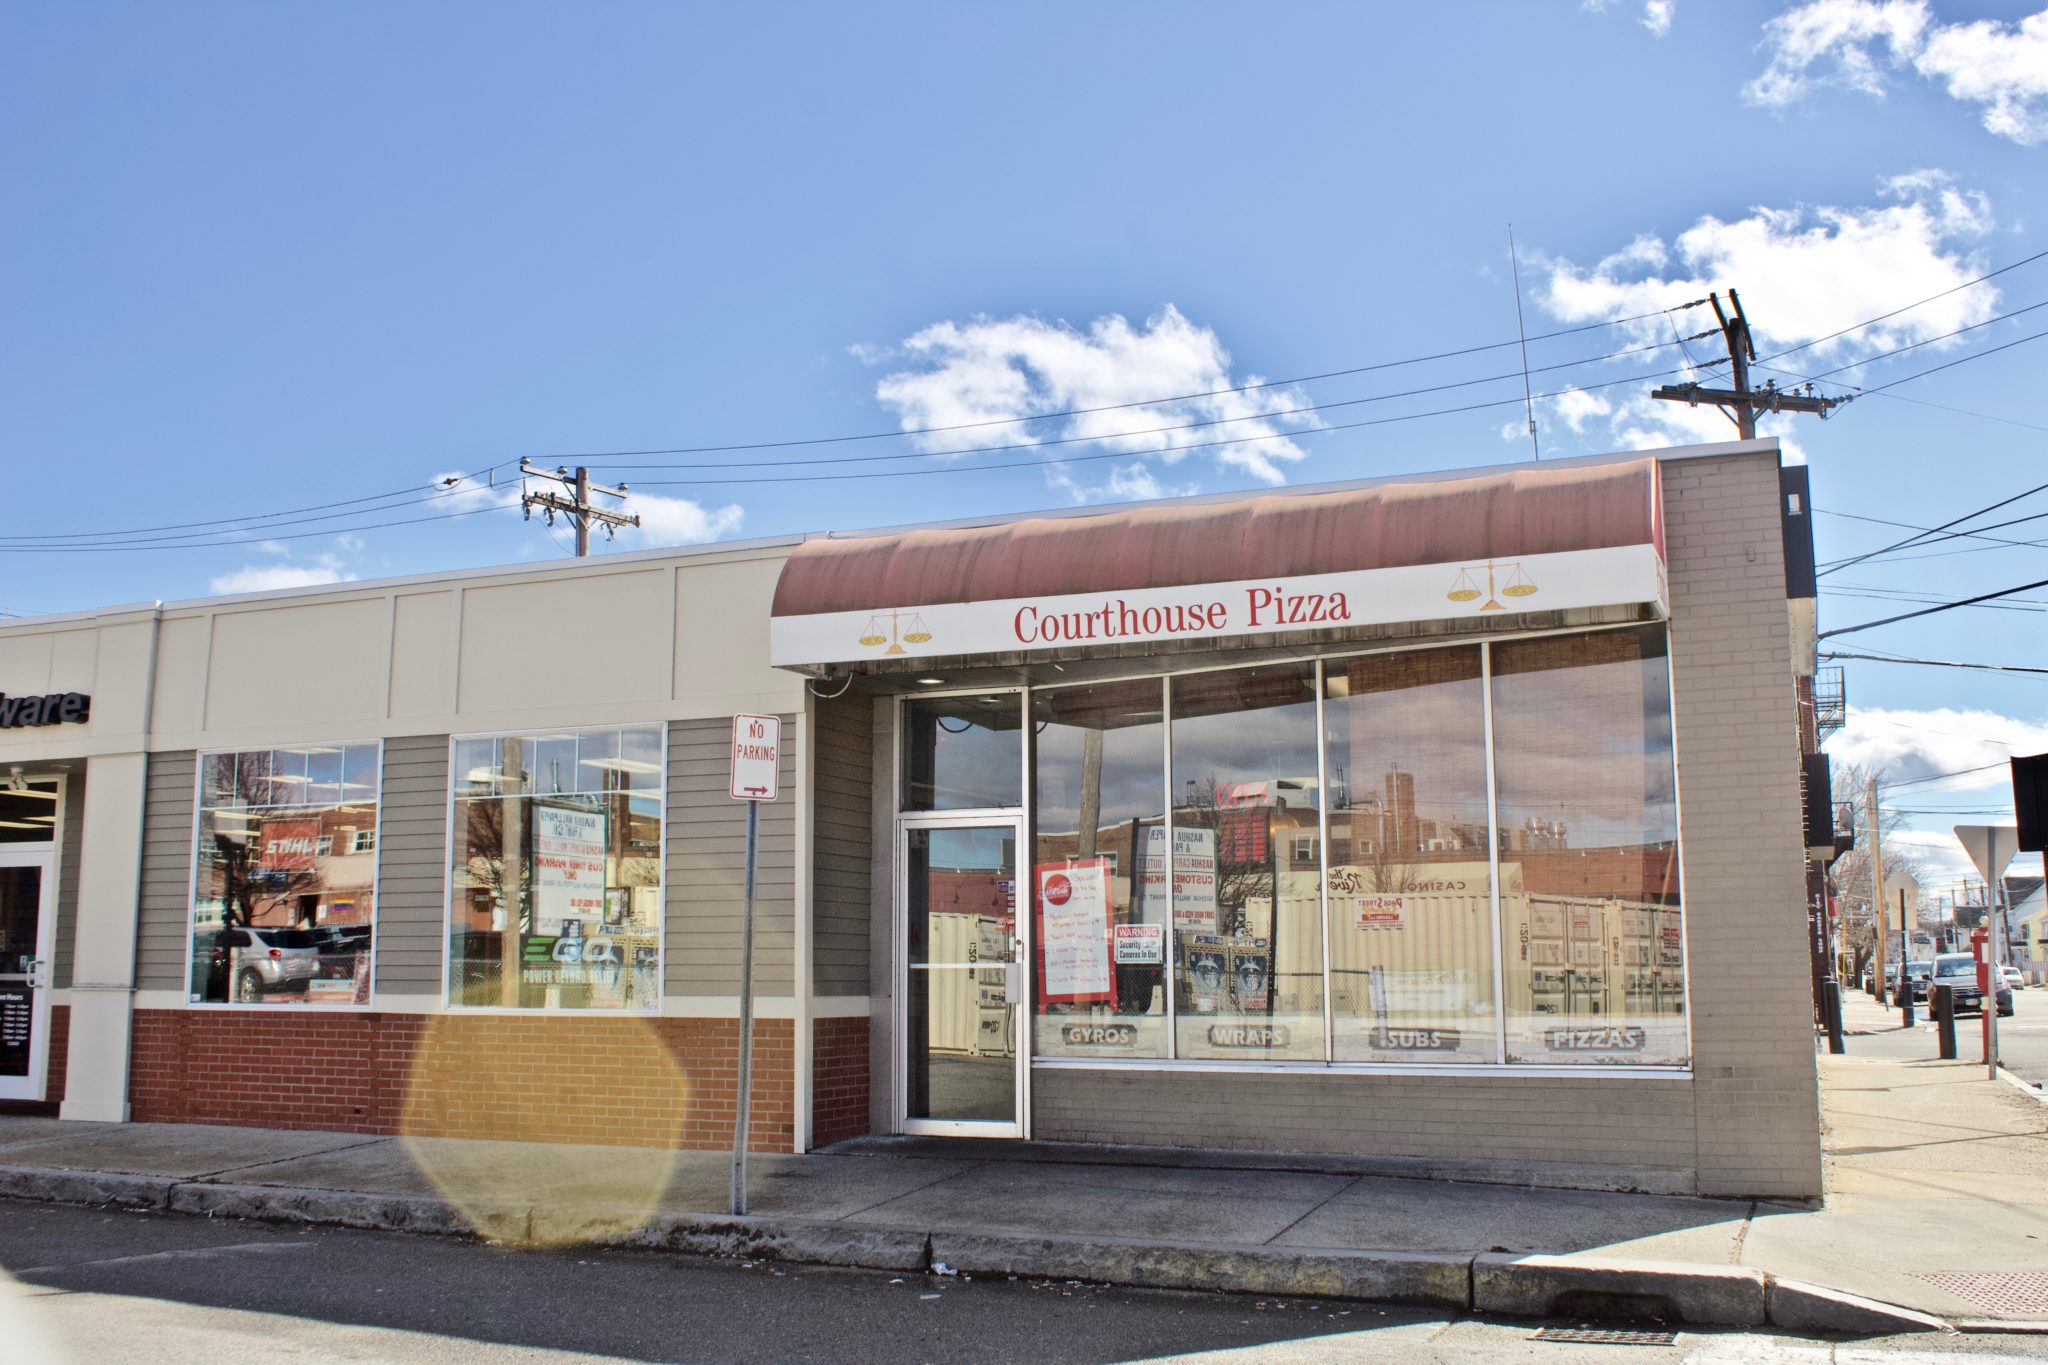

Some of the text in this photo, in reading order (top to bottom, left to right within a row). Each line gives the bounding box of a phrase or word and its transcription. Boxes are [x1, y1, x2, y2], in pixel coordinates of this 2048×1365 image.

[1014, 586, 1351, 643] Courthouse Pizza
[749, 723, 764, 739] NO
[737, 745, 775, 761] PARKING
[267, 838, 313, 854] STIHL
[1120, 928, 1157, 937] WARNING
[1119, 940, 1141, 950] Security
[1120, 950, 1140, 959] Cameras
[1148, 950, 1157, 958] Use
[1069, 1027, 1129, 1044] GYROS
[1213, 1027, 1283, 1046] WRAPS
[1387, 1030, 1441, 1048] SUBS
[1553, 1030, 1638, 1049] PIZZAS
